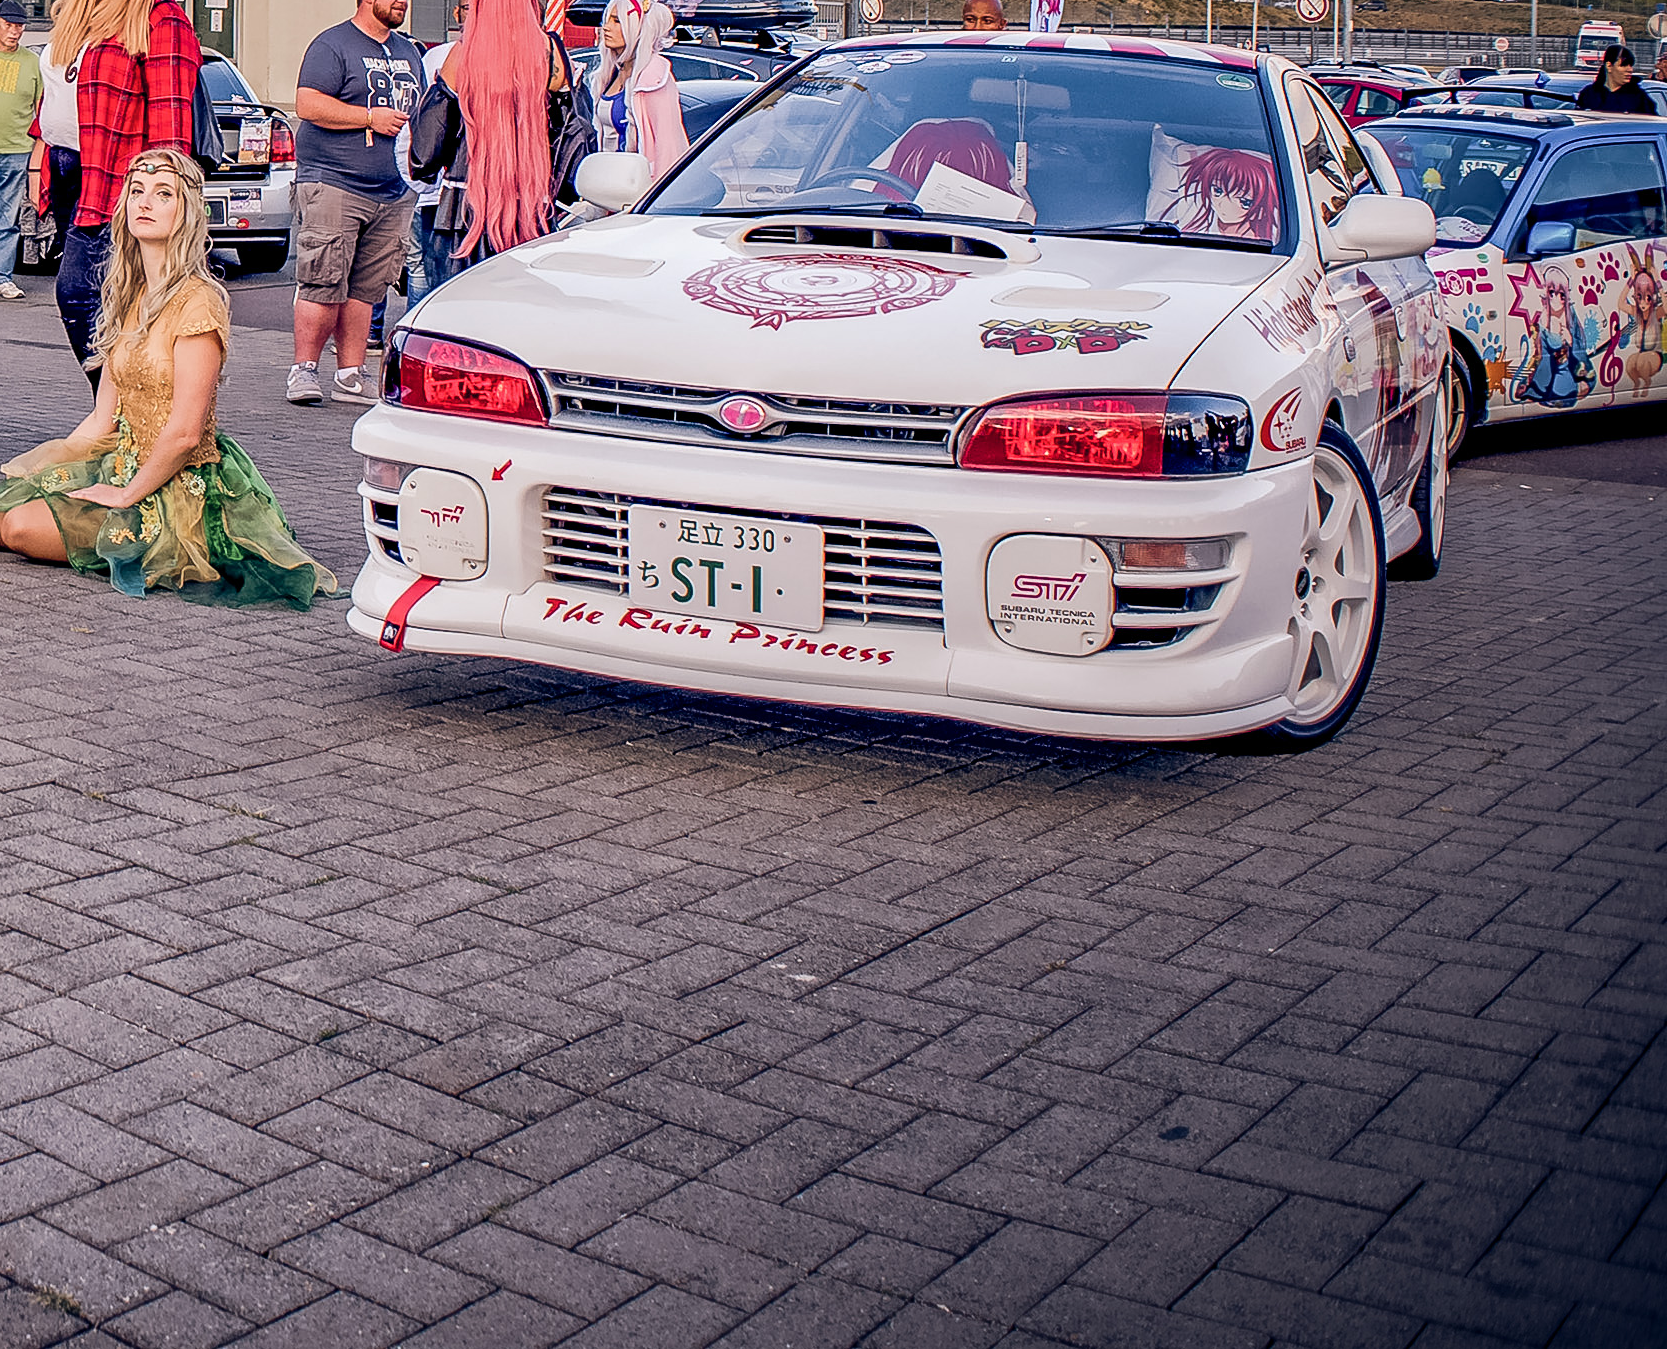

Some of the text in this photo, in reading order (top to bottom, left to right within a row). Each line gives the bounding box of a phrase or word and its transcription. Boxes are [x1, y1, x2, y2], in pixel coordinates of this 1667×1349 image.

[677, 517, 775, 553] 足立 330
[637, 560, 660, 589] ち
[1000, 604, 1096, 619] SUBARU TECNICA
[1000, 612, 1095, 626] INTERNATIONAL
[542, 597, 896, 666] The Ruin Princess
